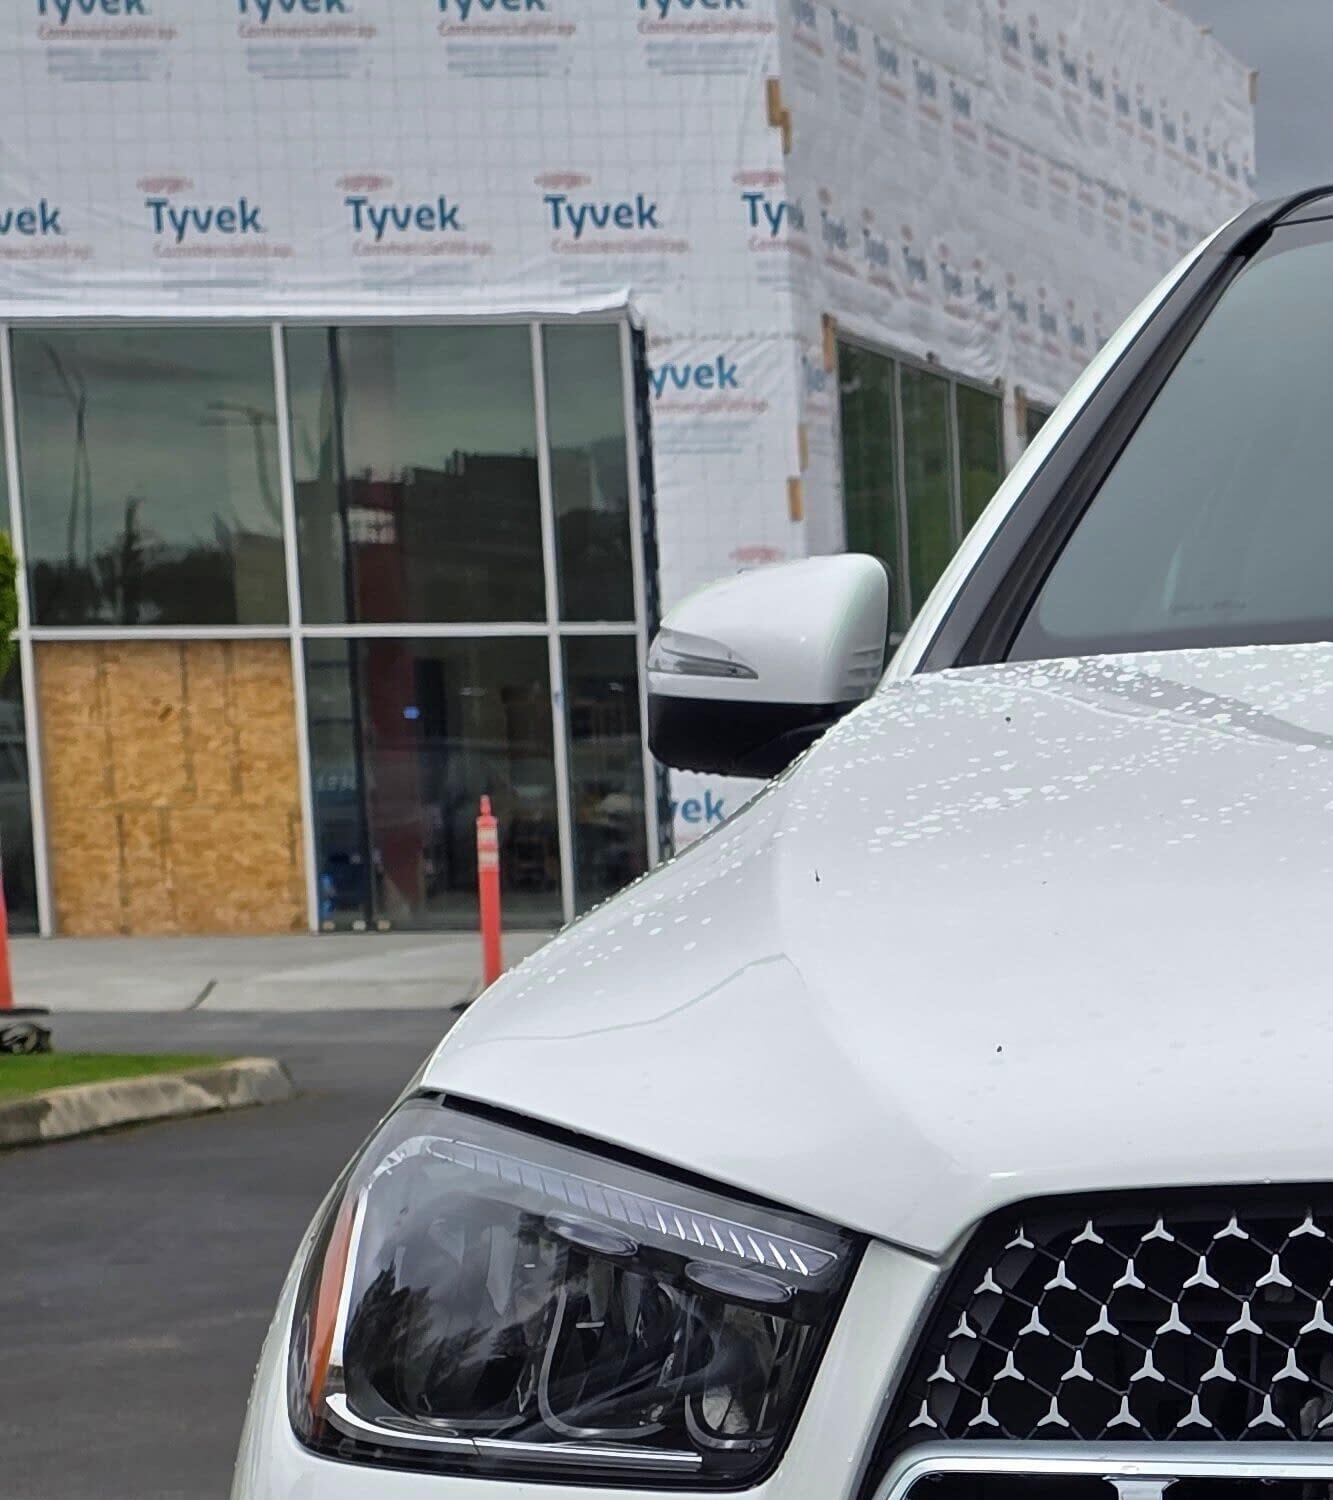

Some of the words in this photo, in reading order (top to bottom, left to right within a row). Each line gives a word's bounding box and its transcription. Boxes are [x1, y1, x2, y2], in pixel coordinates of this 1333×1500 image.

[145, 197, 261, 243] Tyvek
[344, 195, 460, 241] Tyvek
[543, 194, 659, 239] Tyvek
